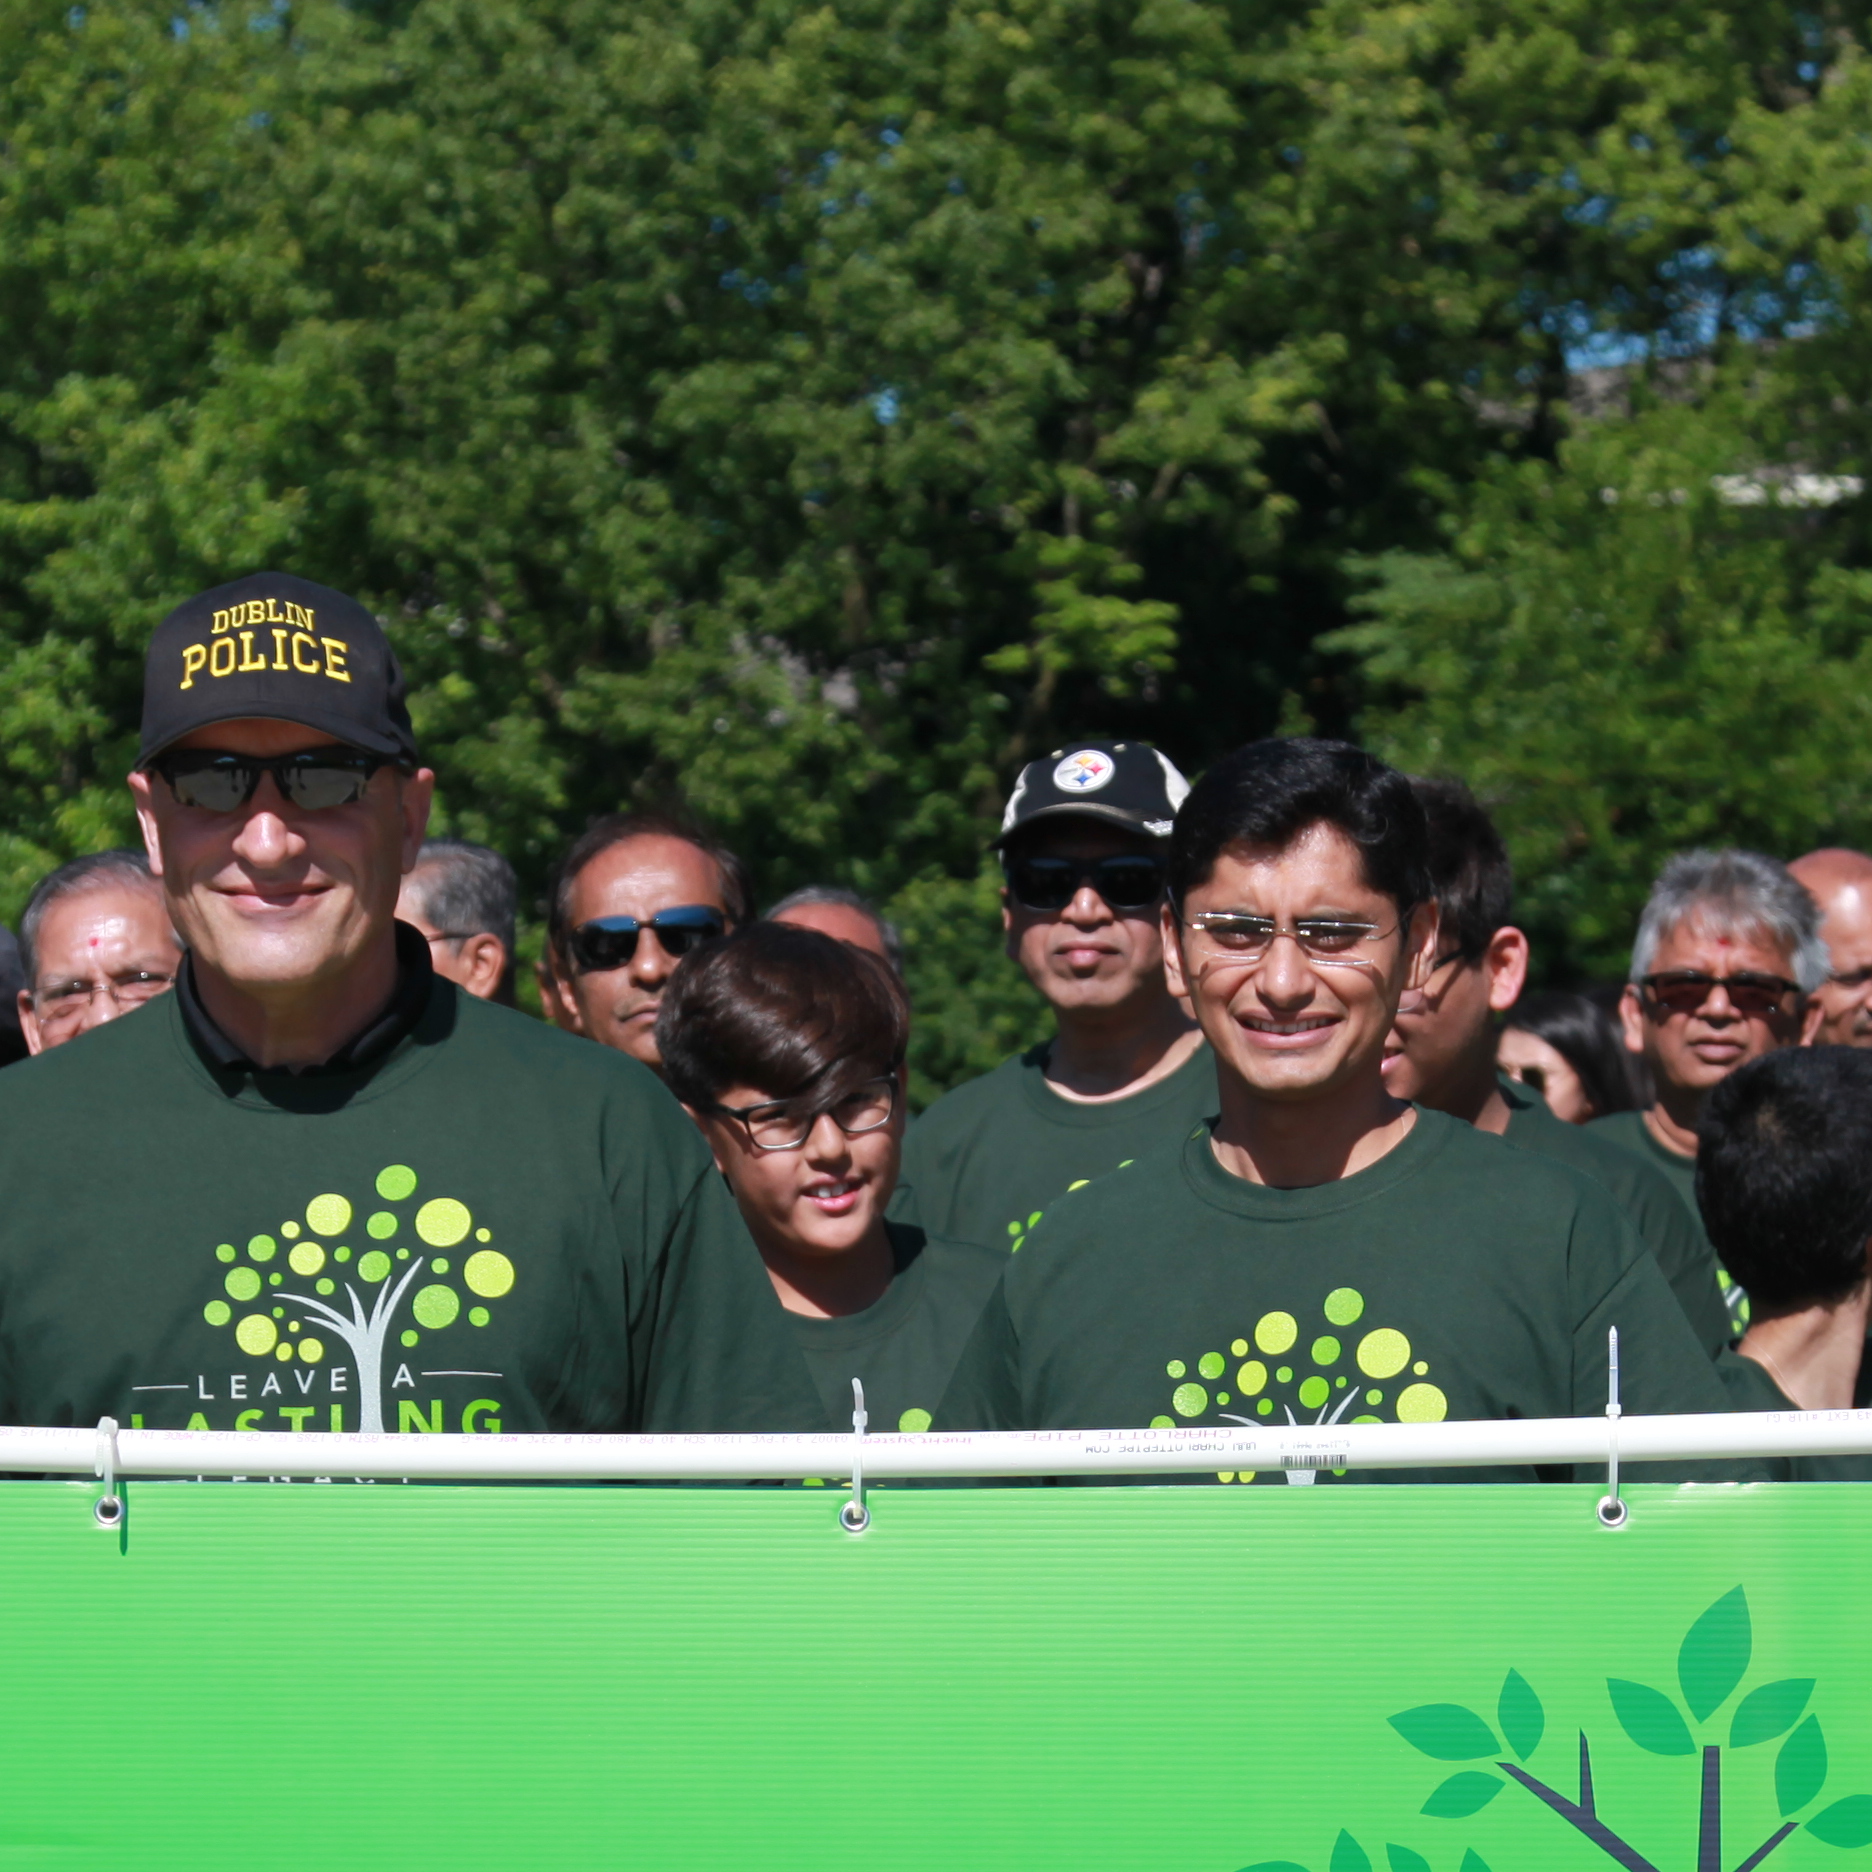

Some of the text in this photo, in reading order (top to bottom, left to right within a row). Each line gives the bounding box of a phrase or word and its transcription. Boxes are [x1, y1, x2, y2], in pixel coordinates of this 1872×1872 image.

[211, 598, 315, 633] DUBLIN
[180, 628, 352, 690] POLICE
[198, 1363, 415, 1399] LEAVE A
[1024, 1432, 1082, 1442] PIPE
[1099, 1430, 1232, 1441] CHARLOTTE
